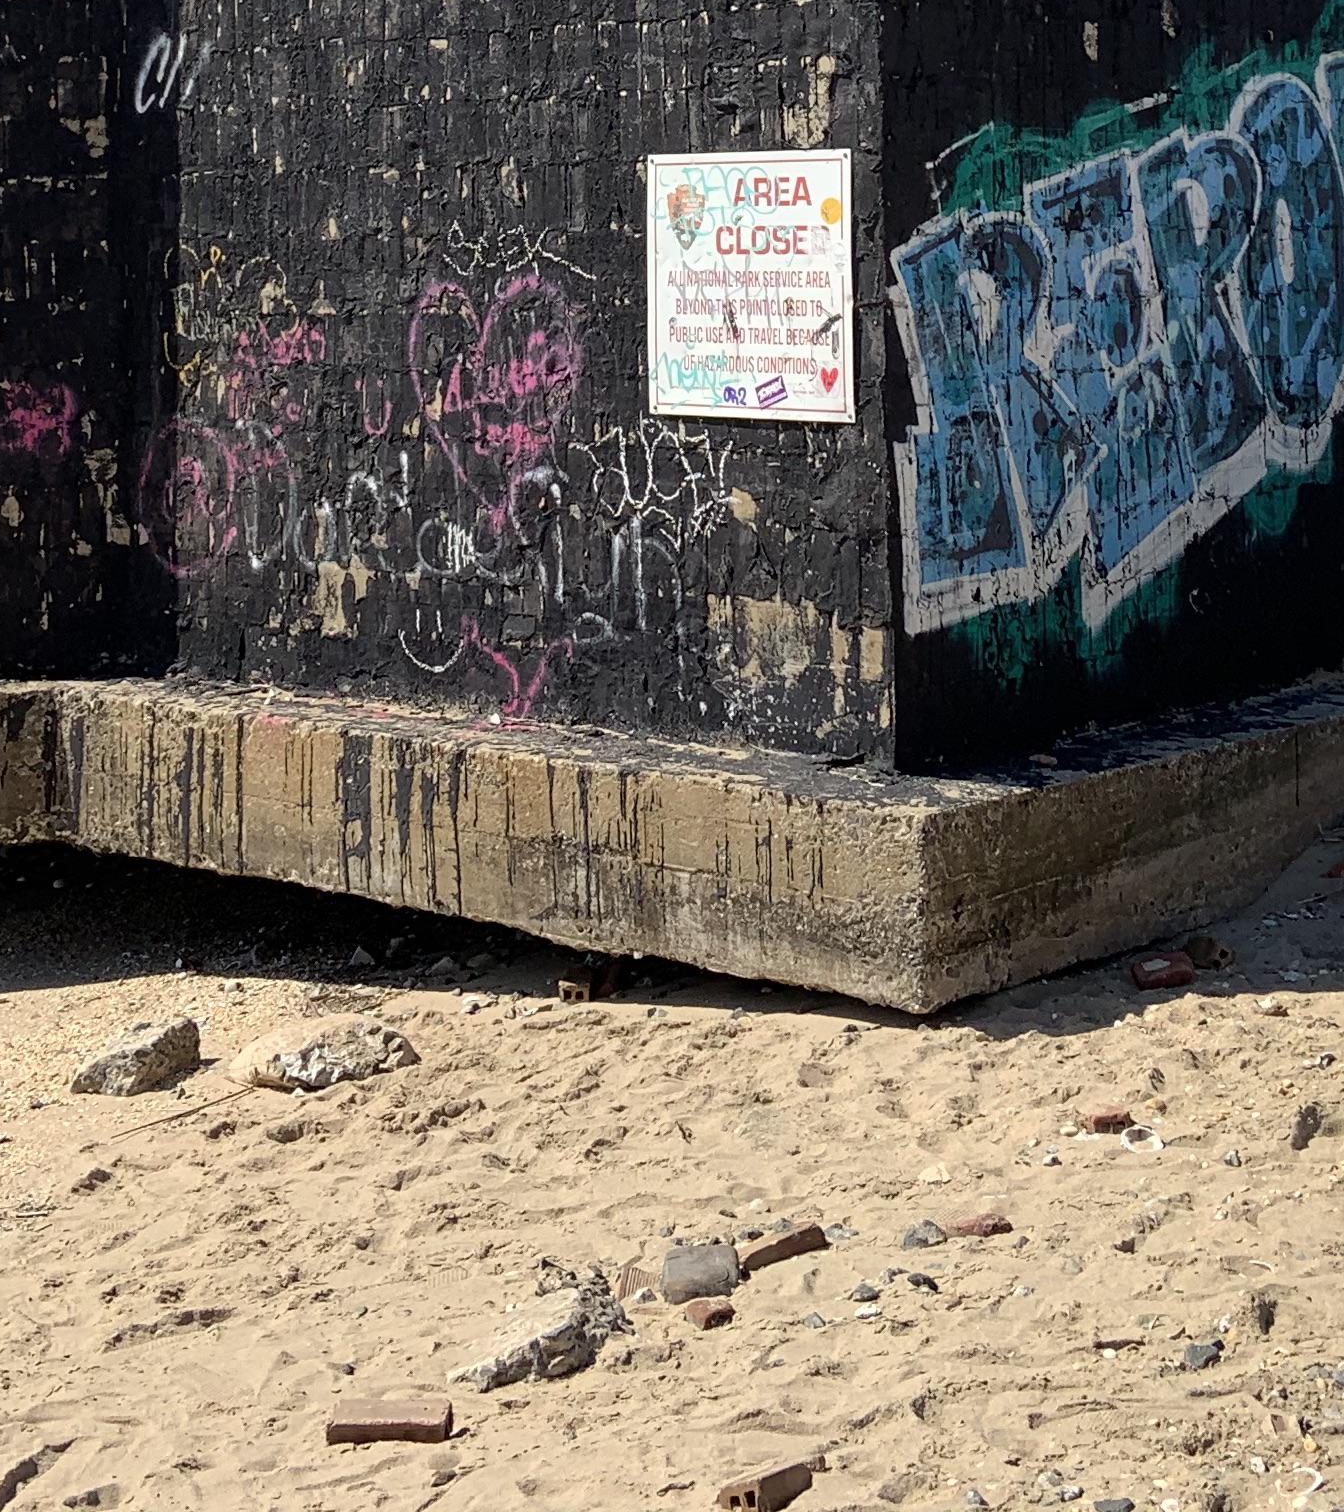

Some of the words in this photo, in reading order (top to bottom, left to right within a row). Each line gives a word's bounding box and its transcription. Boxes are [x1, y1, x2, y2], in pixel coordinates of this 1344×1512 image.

[733, 176, 812, 207] AREA
[685, 271, 733, 288] NATIONAL
[735, 271, 760, 288] PARK
[763, 271, 804, 289] SERVICE
[806, 271, 831, 289] AREA
[676, 298, 714, 316] BEYOND
[739, 299, 769, 317] POINT
[770, 299, 807, 317] CLOSED
[809, 299, 823, 318] TO
[669, 326, 704, 343] PUBLIC
[705, 327, 723, 344] USE
[748, 328, 784, 345] TRAVEL
[786, 328, 830, 346] BECAUSE
[684, 355, 698, 371] OF
[697, 356, 755, 374] HAZARDOUS
[757, 356, 818, 376] CONDITIONS
